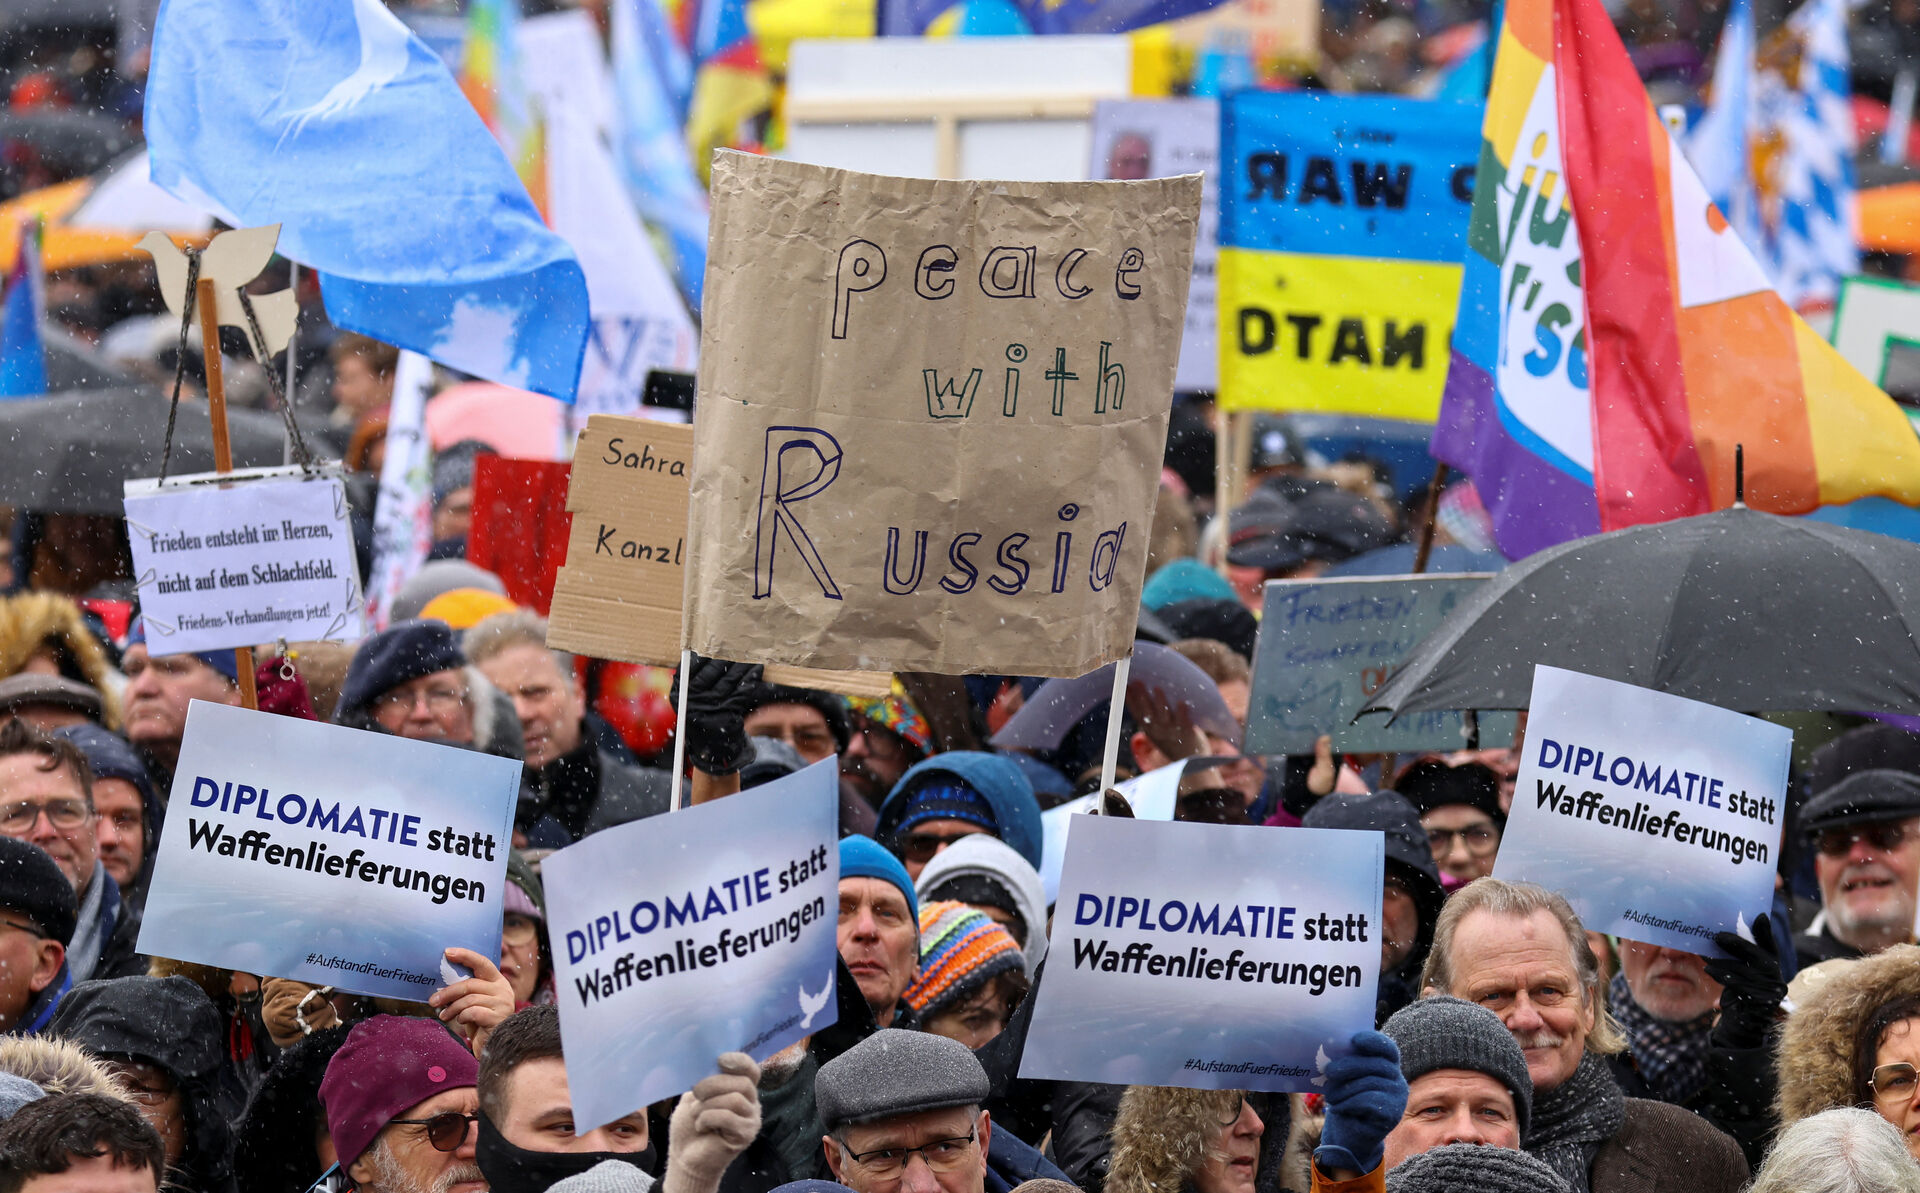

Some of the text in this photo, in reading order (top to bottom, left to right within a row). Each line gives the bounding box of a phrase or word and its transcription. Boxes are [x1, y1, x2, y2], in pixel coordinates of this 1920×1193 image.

[832, 239, 1144, 339] peace
[922, 341, 1126, 418] with
[602, 438, 685, 477] Sahra
[150, 530, 202, 553] Frieden
[205, 524, 259, 548] entsteht
[281, 520, 333, 541] Herzen,
[753, 426, 1127, 600] Russia
[157, 558, 337, 595] nicht auf dem Schlachtfeld.
[177, 602, 331, 632] Friedens-Verhandlungen jetzt!
[190, 776, 496, 862] DIPLOMATIE statt
[1538, 738, 1724, 809] DIPLOMATIE
[1727, 790, 1775, 825] statt
[1536, 779, 1769, 865] Waffenlieferungen
[188, 818, 486, 905] Waffenlieferungen
[565, 844, 828, 965] DIPLOMATIE statt
[1074, 893, 1369, 943] DIPLOMATIE statt
[305, 952, 437, 987] #AufstandFuerFrieden
[574, 896, 825, 1009] Waffenlieferungen
[1073, 938, 1362, 996] Waffenlieferungen
[1183, 1057, 1311, 1078] #AufstandFuerFrieden
